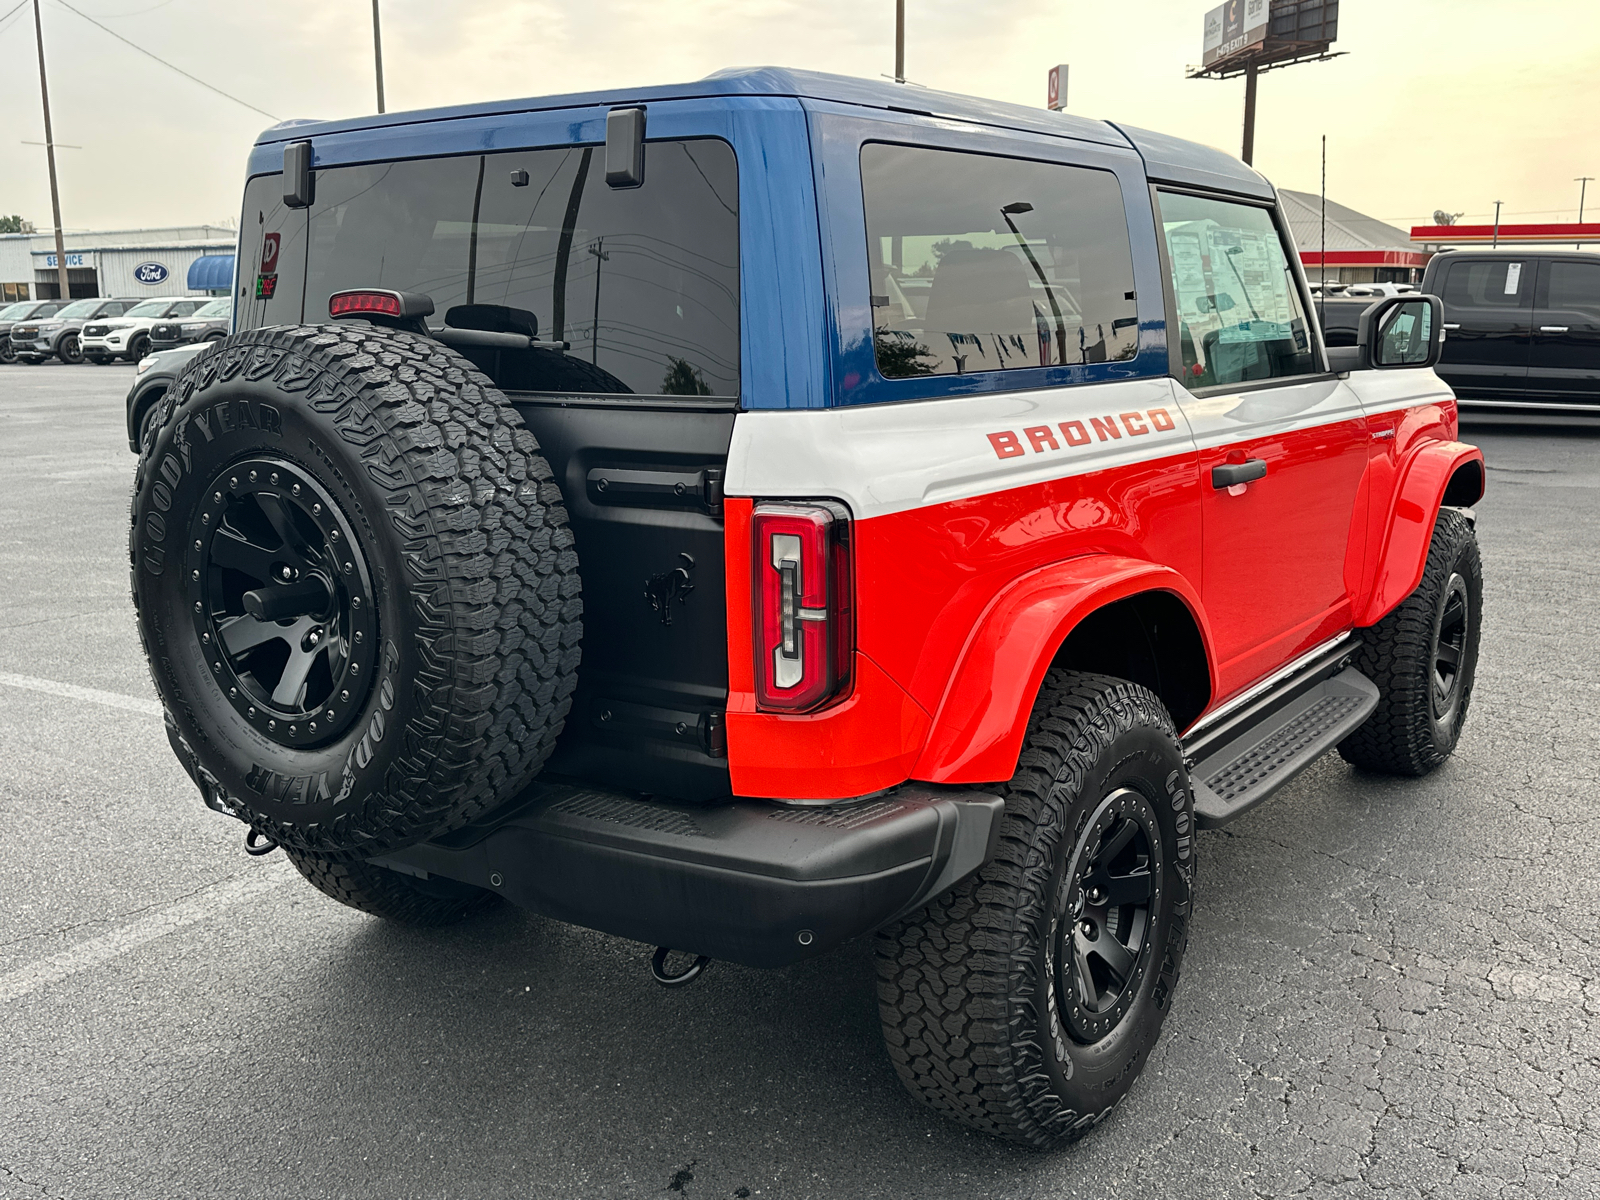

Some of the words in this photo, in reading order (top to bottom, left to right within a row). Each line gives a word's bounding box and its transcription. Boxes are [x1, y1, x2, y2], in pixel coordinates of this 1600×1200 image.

[1230, 35, 1244, 51] EXIT
[1243, 33, 1248, 45] 9
[46, 254, 83, 267] SEVICE
[140, 264, 162, 281] Ford
[986, 408, 1176, 460] BRONCO
